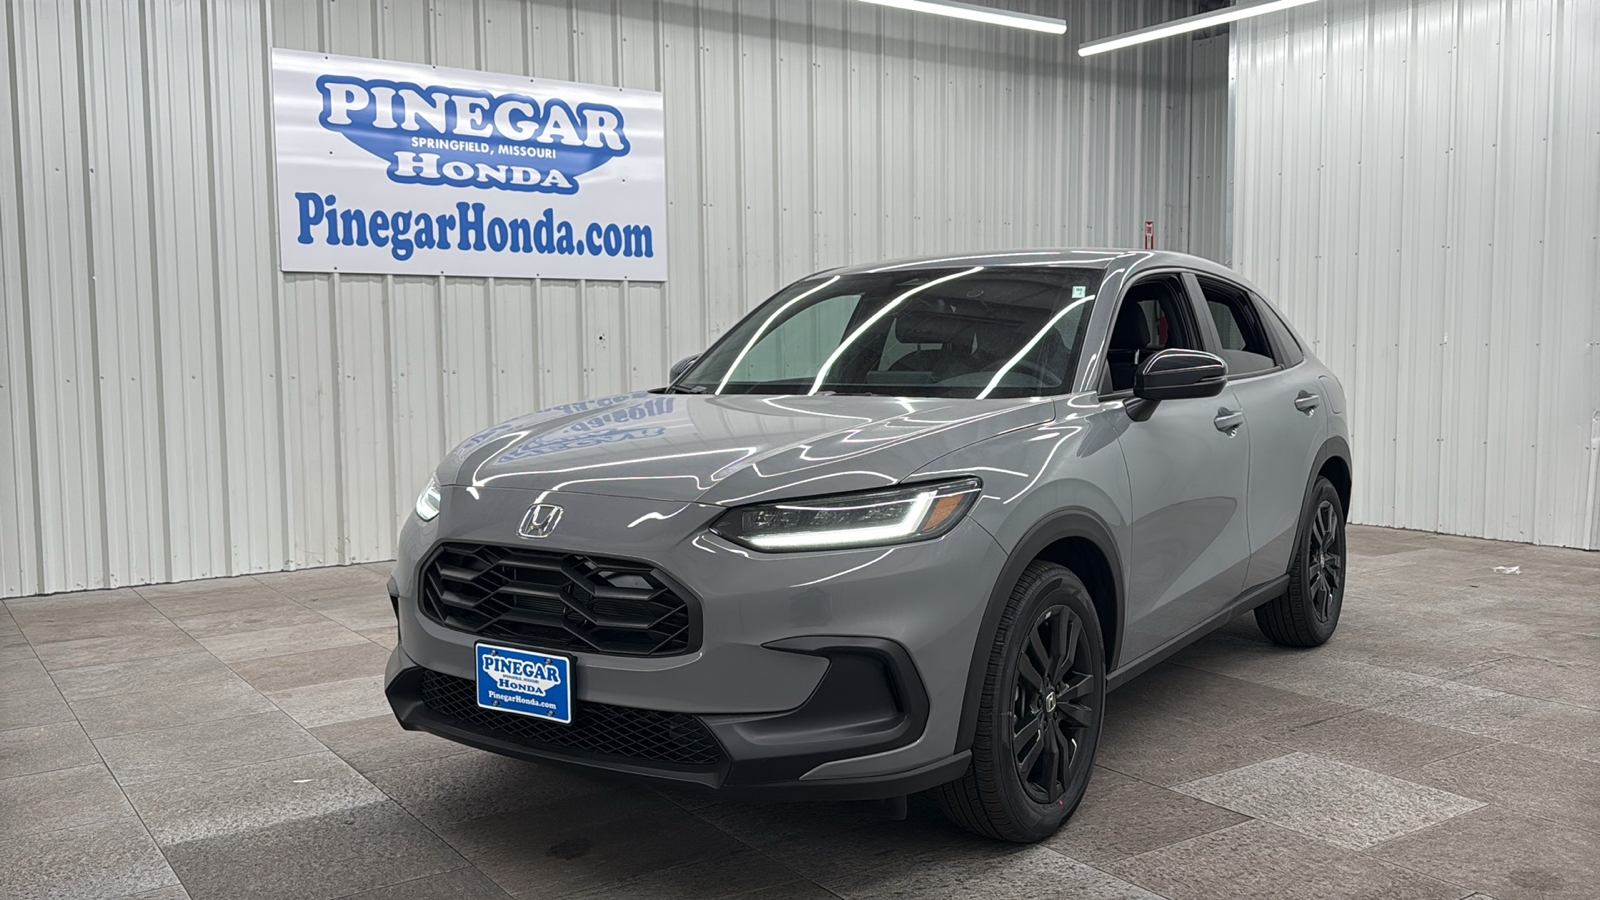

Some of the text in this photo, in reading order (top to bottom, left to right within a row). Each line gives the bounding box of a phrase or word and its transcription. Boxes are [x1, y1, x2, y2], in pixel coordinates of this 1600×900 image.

[324, 82, 625, 150] PINEGAR
[411, 136, 557, 159] SPRINGFIELD, MISSOURI
[394, 151, 573, 189] HONDA
[295, 192, 654, 261] PinegarHonda.com
[483, 656, 560, 682] PINEGAR
[499, 678, 544, 694] HONDA
[488, 690, 557, 709] PinegarHonda.com
